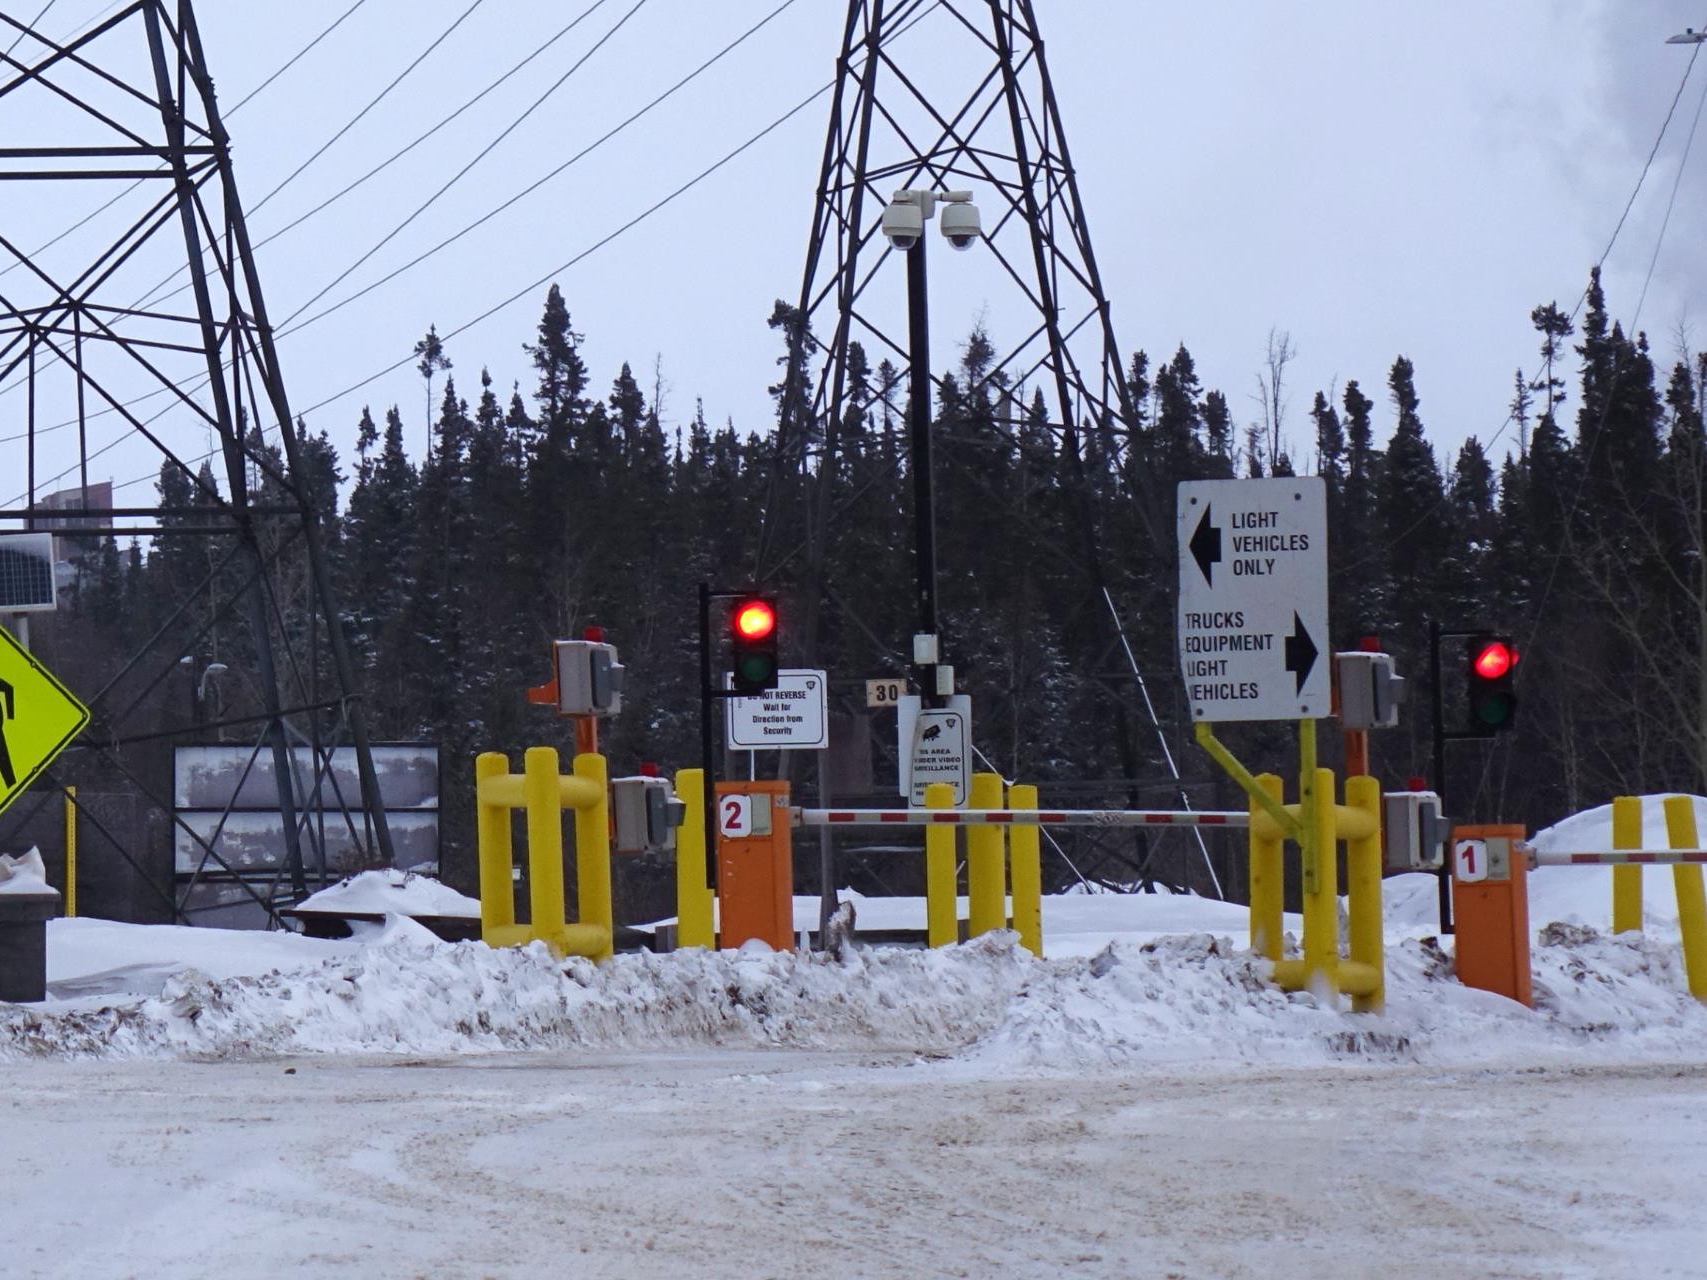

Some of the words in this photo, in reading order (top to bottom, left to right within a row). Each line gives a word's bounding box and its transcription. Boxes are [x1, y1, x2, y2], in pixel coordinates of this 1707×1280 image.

[1232, 511, 1279, 529] LIGHT
[1232, 534, 1310, 552] VEHICLES
[1233, 558, 1276, 576] ONLY
[1185, 611, 1244, 629] TRUCKS
[1186, 634, 1274, 653] EQUIPMENT
[775, 690, 807, 700] REVERSE
[876, 685, 898, 701] 30
[763, 703, 780, 711] Wait
[781, 703, 791, 711] for
[752, 715, 785, 723] Direction
[786, 715, 803, 723] from
[763, 726, 792, 735] Security
[725, 801, 742, 829] 2
[1461, 845, 1476, 874] 1
